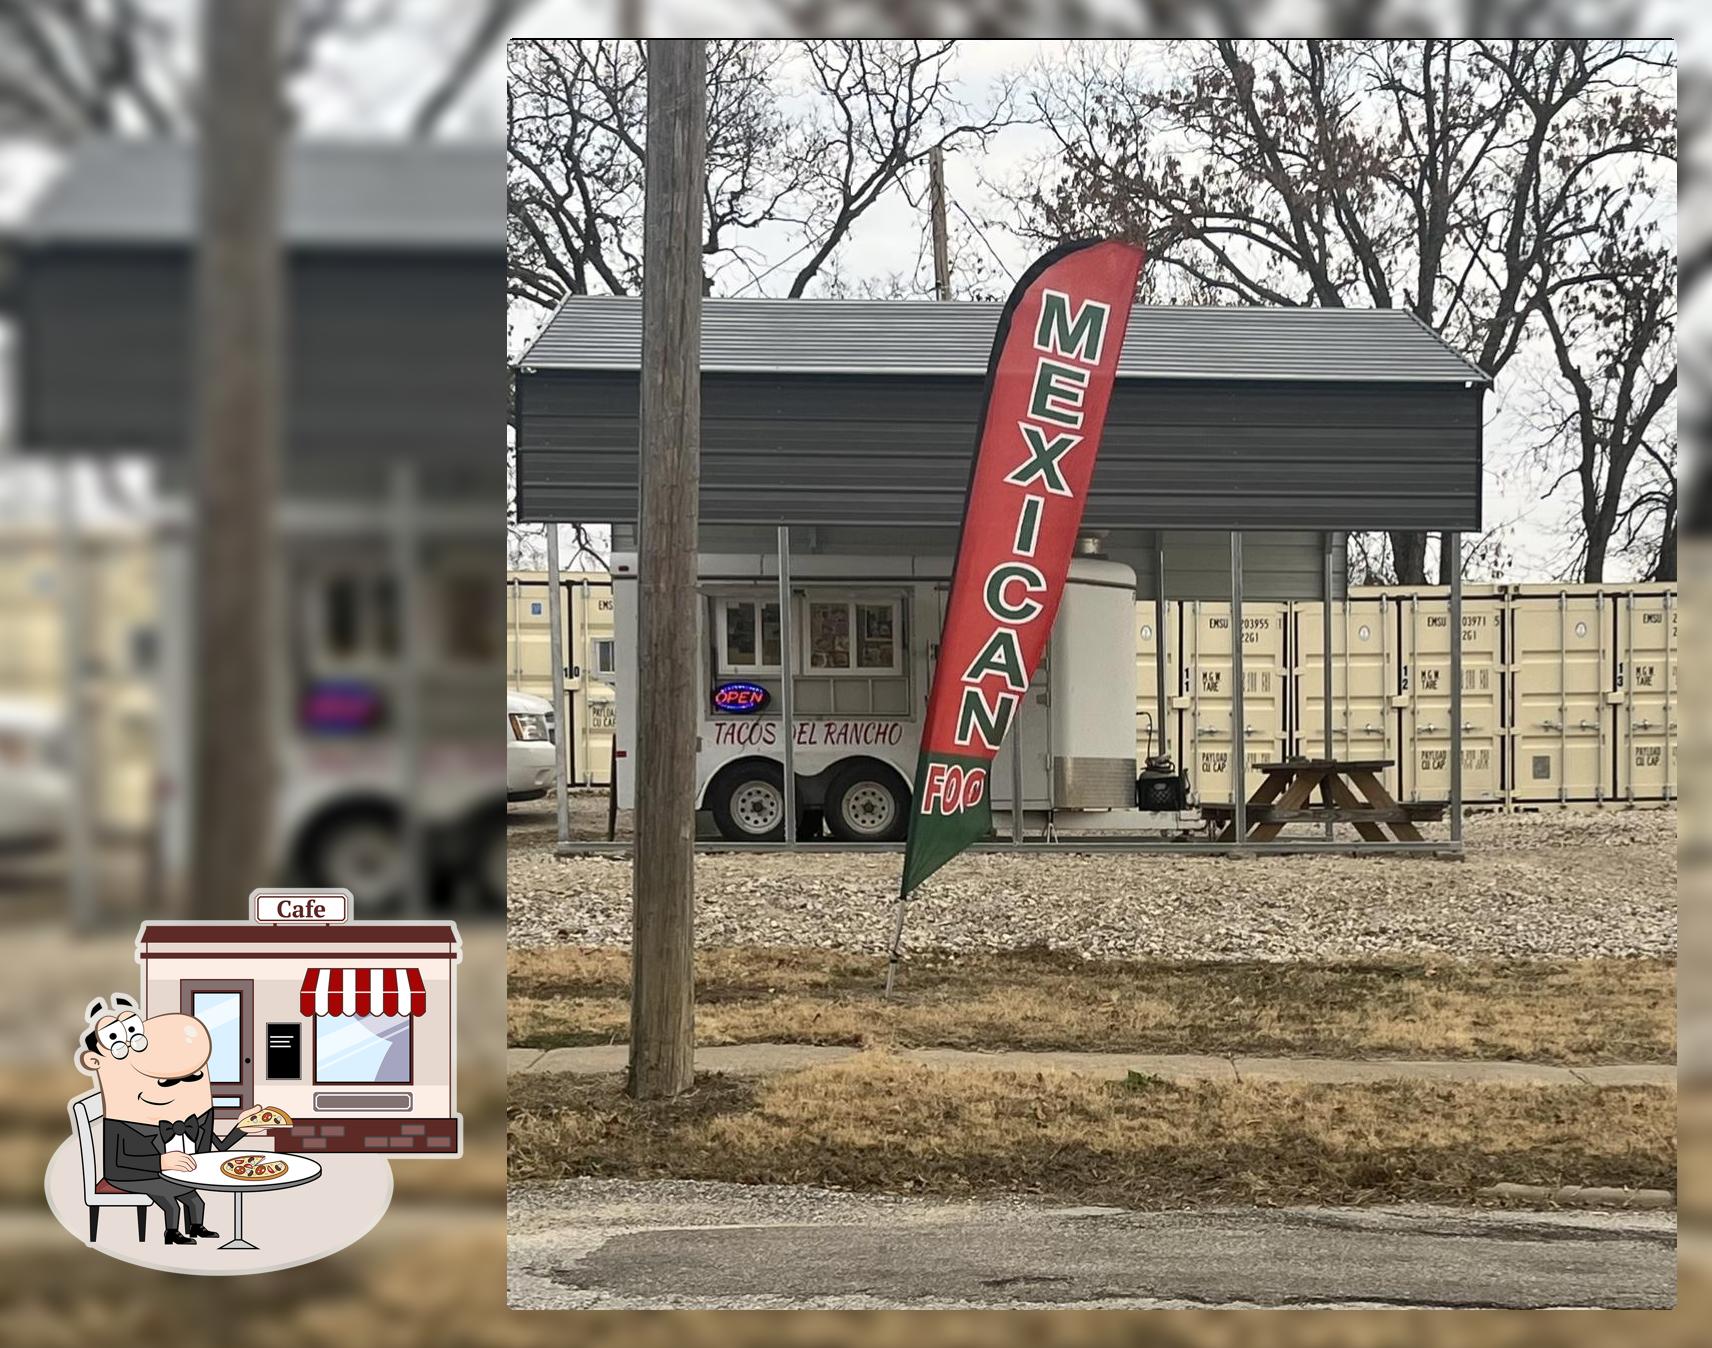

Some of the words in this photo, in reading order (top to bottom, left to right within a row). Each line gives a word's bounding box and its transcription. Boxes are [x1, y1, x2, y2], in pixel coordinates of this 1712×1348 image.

[954, 288, 1111, 750] MEXICAN
[598, 600, 614, 611] EMS
[1209, 618, 1229, 629] EMSU
[1427, 616, 1447, 627] EMSU
[1462, 616, 1487, 627] 03971
[1462, 630, 1477, 641] 2G1
[715, 691, 764, 705] OPEN
[714, 722, 777, 746] TACOS
[823, 722, 903, 746] RANCHO
